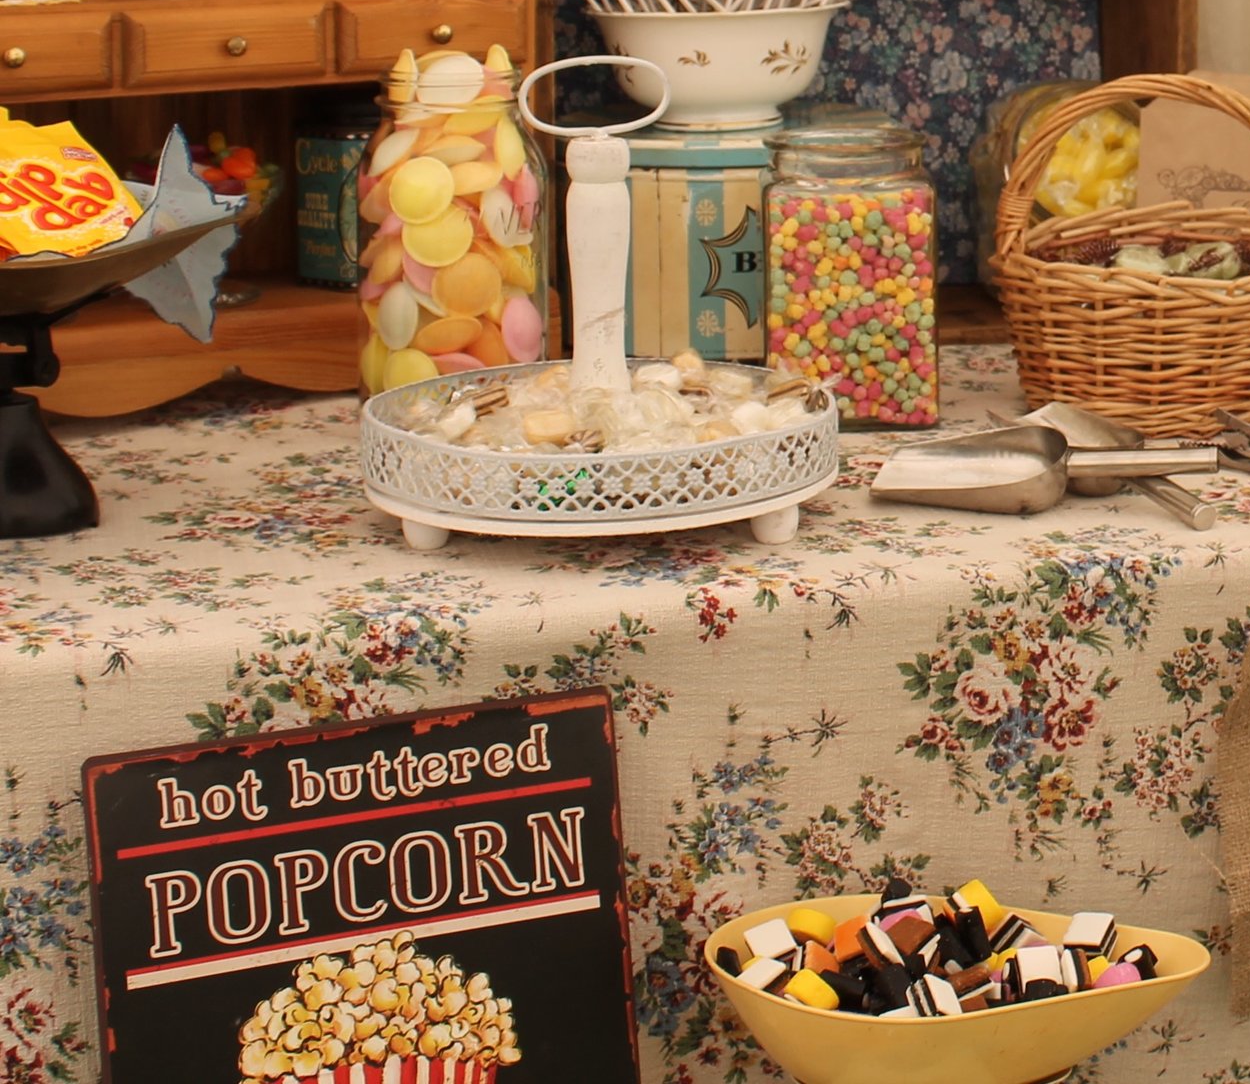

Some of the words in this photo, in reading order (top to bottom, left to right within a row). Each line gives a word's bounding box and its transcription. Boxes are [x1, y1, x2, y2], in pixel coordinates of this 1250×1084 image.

[30, 172, 115, 231] dab
[158, 769, 268, 829] hot
[287, 723, 552, 809] buttered
[145, 806, 586, 959] POPCORN
